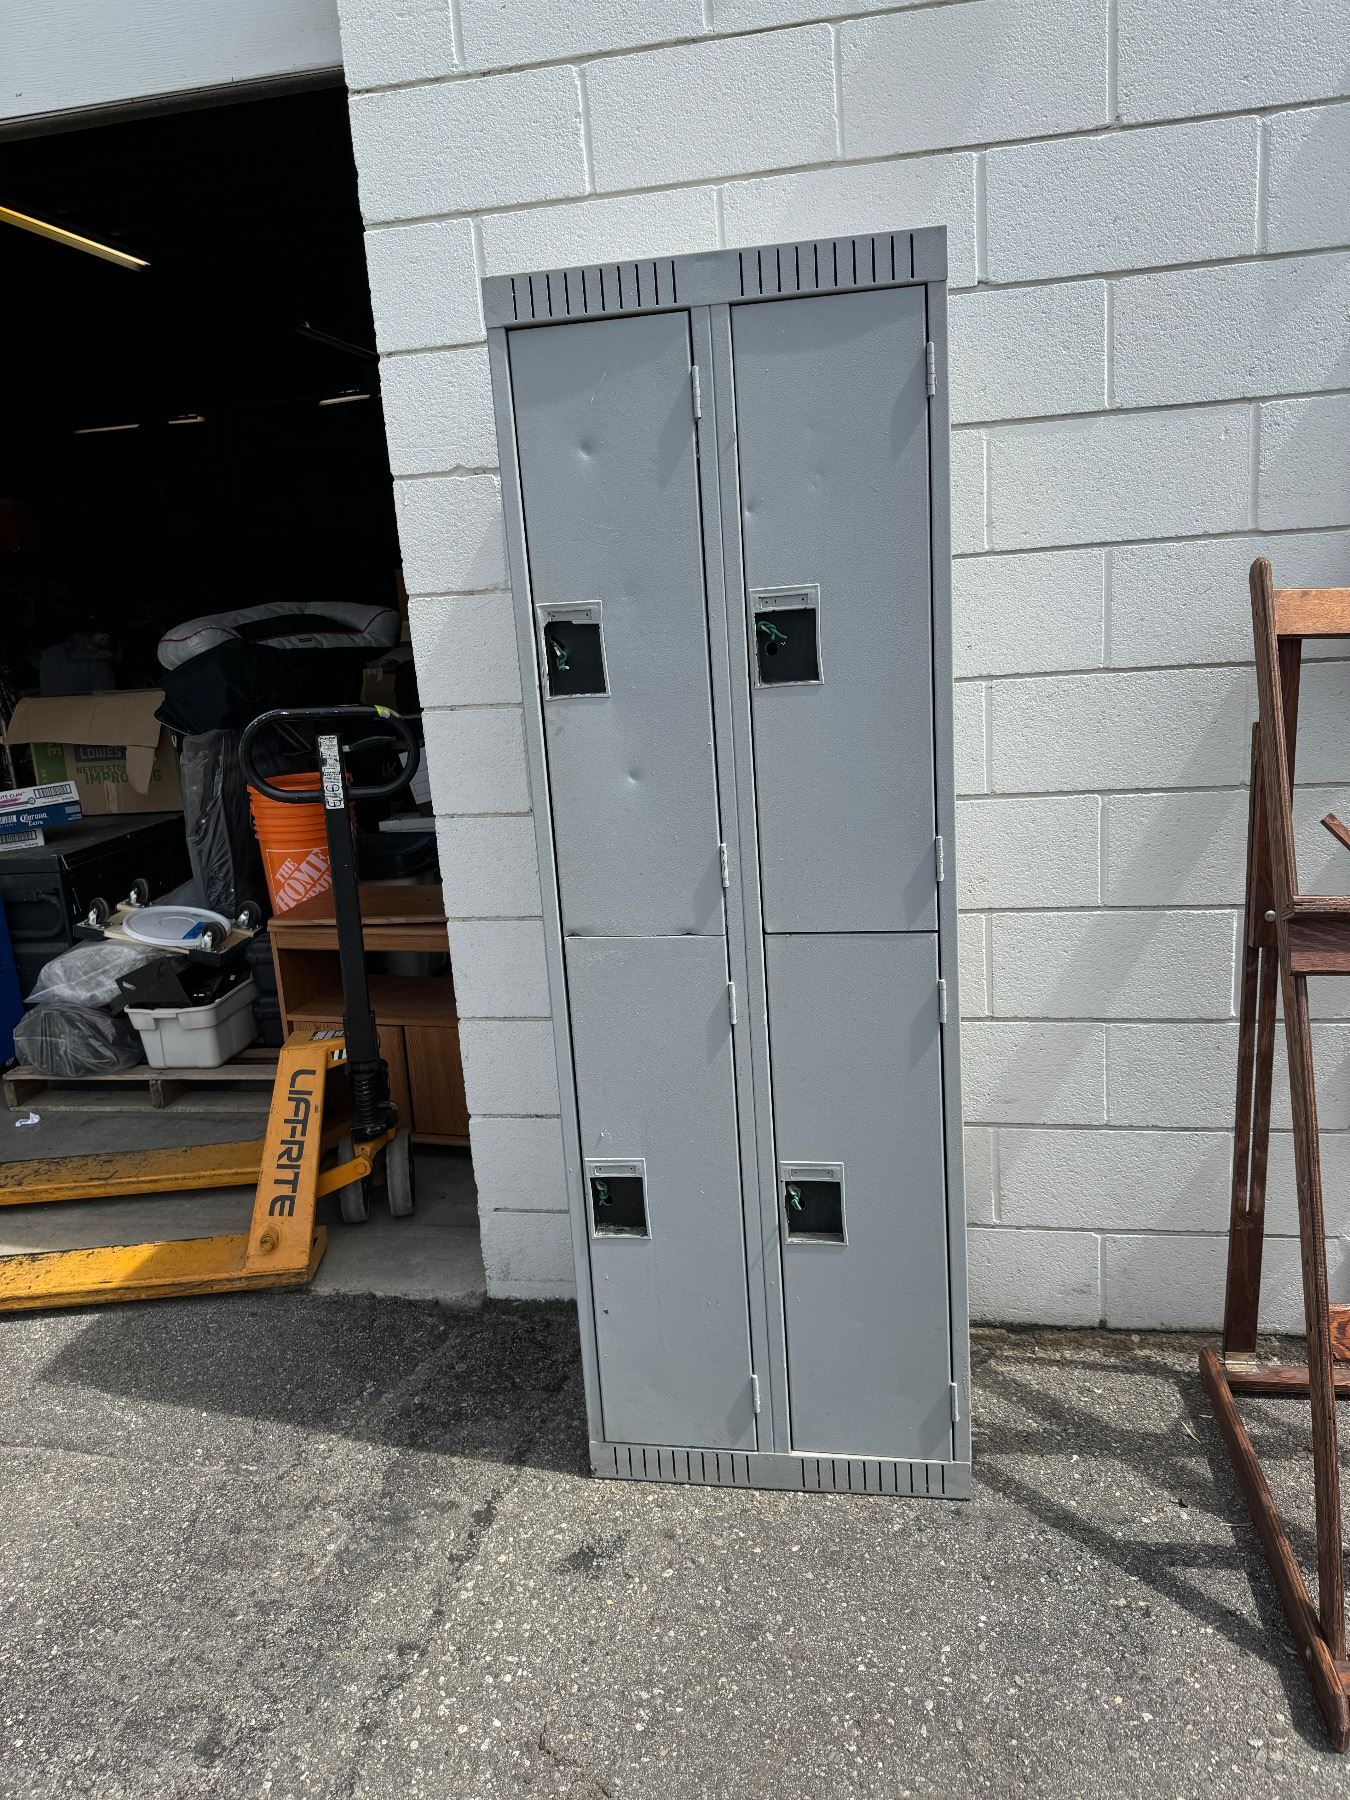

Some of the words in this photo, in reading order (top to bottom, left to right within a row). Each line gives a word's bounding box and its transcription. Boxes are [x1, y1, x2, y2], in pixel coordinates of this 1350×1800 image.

[76, 764, 104, 775] NEVER
[20, 812, 48, 824] Corona
[275, 858, 298, 883] THE
[275, 848, 328, 911] HOME
[268, 1067, 316, 1217] LIFT-RITE
